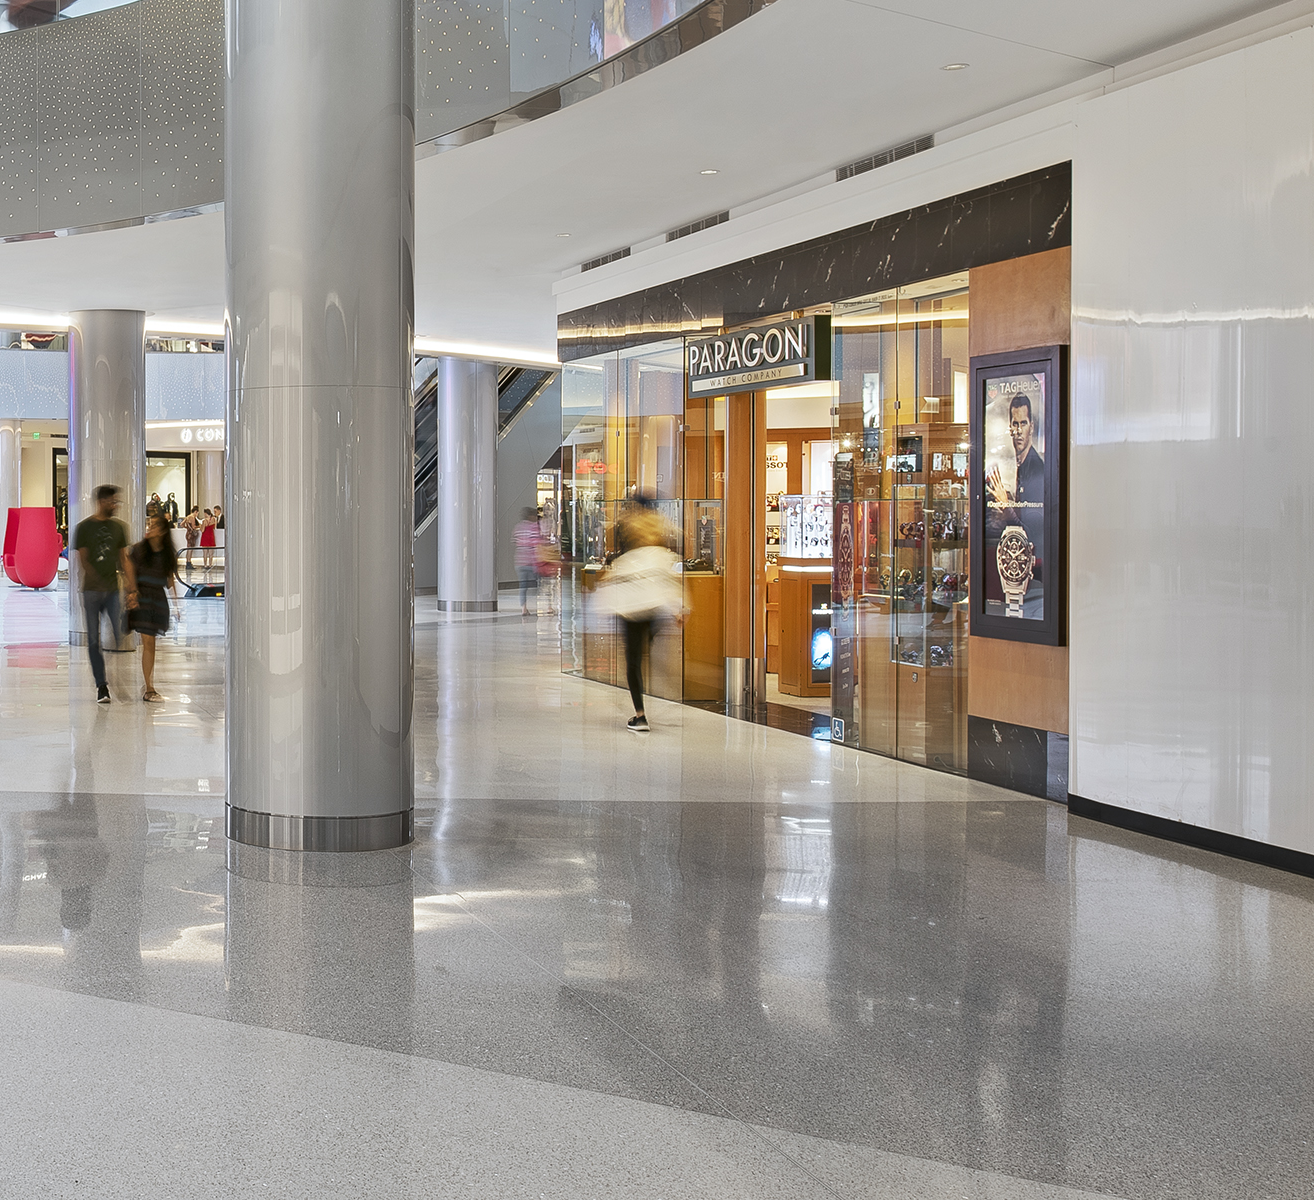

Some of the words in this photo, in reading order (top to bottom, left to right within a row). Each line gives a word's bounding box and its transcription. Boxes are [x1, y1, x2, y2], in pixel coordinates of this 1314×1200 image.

[690, 323, 805, 376] PARAGON
[709, 376, 737, 387] WATCH
[741, 368, 783, 383] COMPANY
